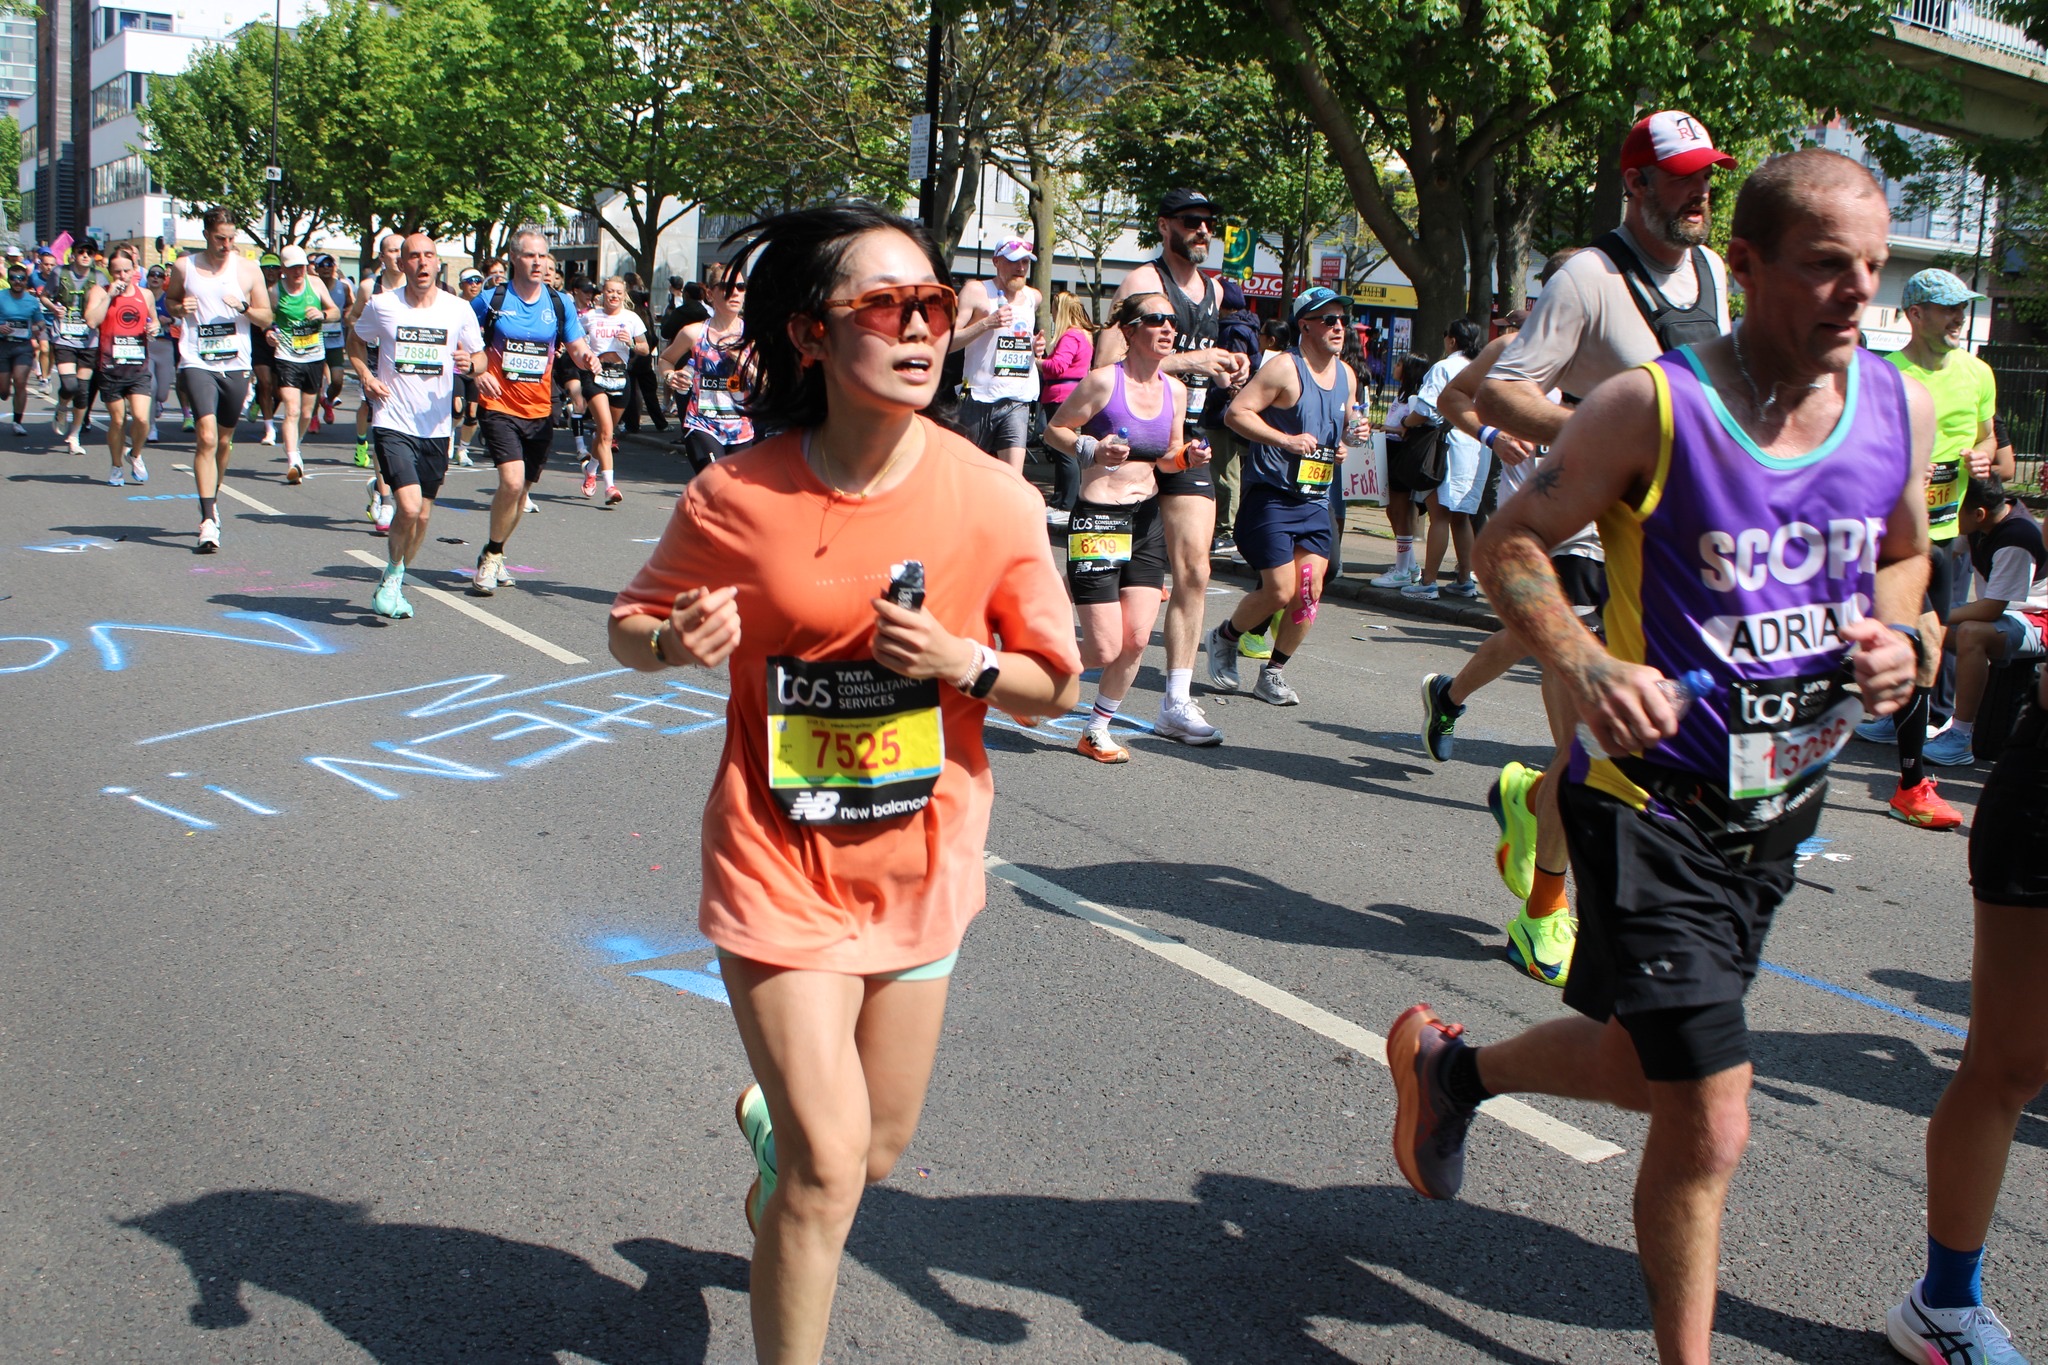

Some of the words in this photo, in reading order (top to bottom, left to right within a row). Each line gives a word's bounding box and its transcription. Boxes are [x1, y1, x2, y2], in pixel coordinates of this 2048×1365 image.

[398, 328, 418, 341] tcs
[506, 339, 524, 352] tcs
[999, 337, 1015, 349] tcs
[403, 346, 439, 360] 78840
[509, 357, 540, 369] 49582
[702, 376, 718, 388] tcs
[1308, 466, 1332, 481] 2641
[1072, 516, 1093, 531] tcs
[1081, 538, 1117, 554] 6209
[1728, 607, 1852, 656] ADRIA
[777, 665, 832, 709] tcs
[836, 670, 874, 682] TATA
[838, 693, 896, 709] SERVICES
[1741, 686, 1798, 725] tcs
[811, 728, 901, 770] 7525
[840, 806, 870, 820] new
[872, 795, 929, 818] balance
